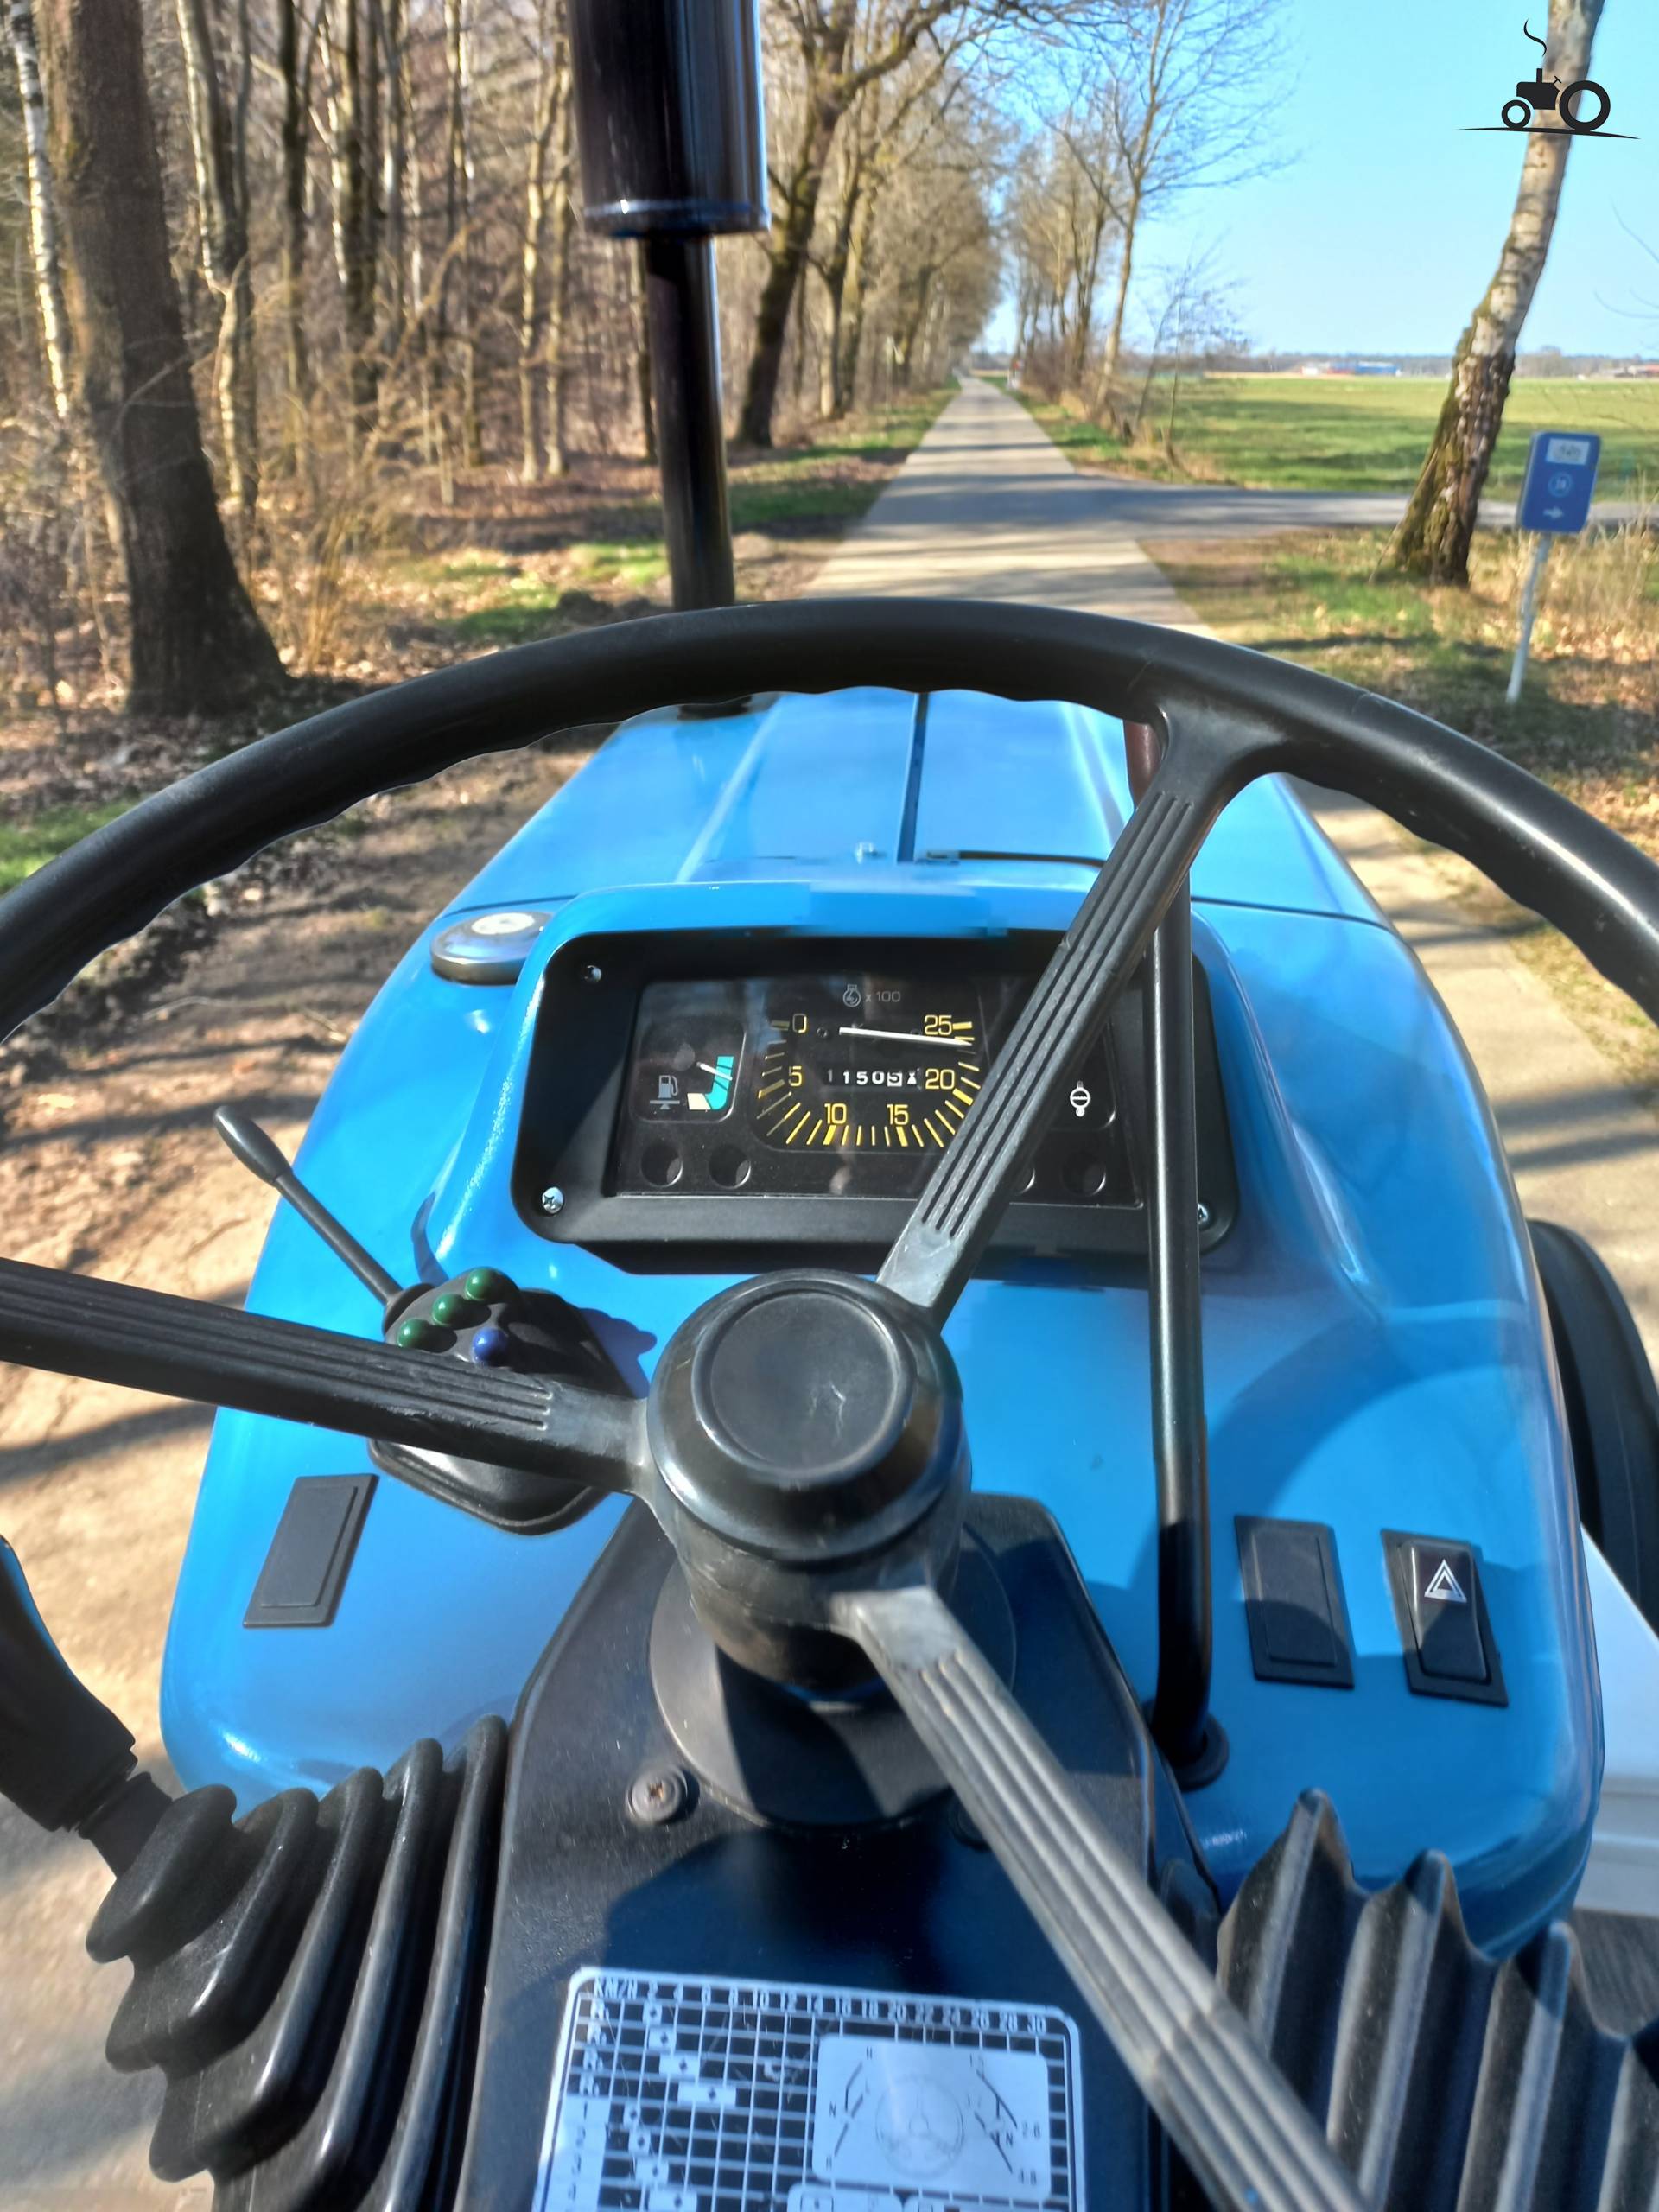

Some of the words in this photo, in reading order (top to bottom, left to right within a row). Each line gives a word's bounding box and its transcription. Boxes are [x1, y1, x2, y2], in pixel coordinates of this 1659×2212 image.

[876, 990, 901, 1003] 100
[792, 1013, 808, 1034] 0
[924, 1014, 953, 1036] 25
[788, 1065, 803, 1087] 5
[925, 1068, 956, 1090] 20
[824, 1103, 848, 1125] 10
[887, 1103, 910, 1126] 15
[593, 1974, 639, 1999] KM/H
[752, 1987, 770, 2012] 10
[780, 1990, 797, 2012] 12
[806, 1992, 823, 2013] 14
[887, 1999, 906, 2022] 20
[915, 2002, 933, 2024] 22
[942, 2005, 960, 2026] 24
[971, 2007, 989, 2029] 26
[999, 2010, 1017, 2031] 28
[1027, 2012, 1046, 2033] 30
